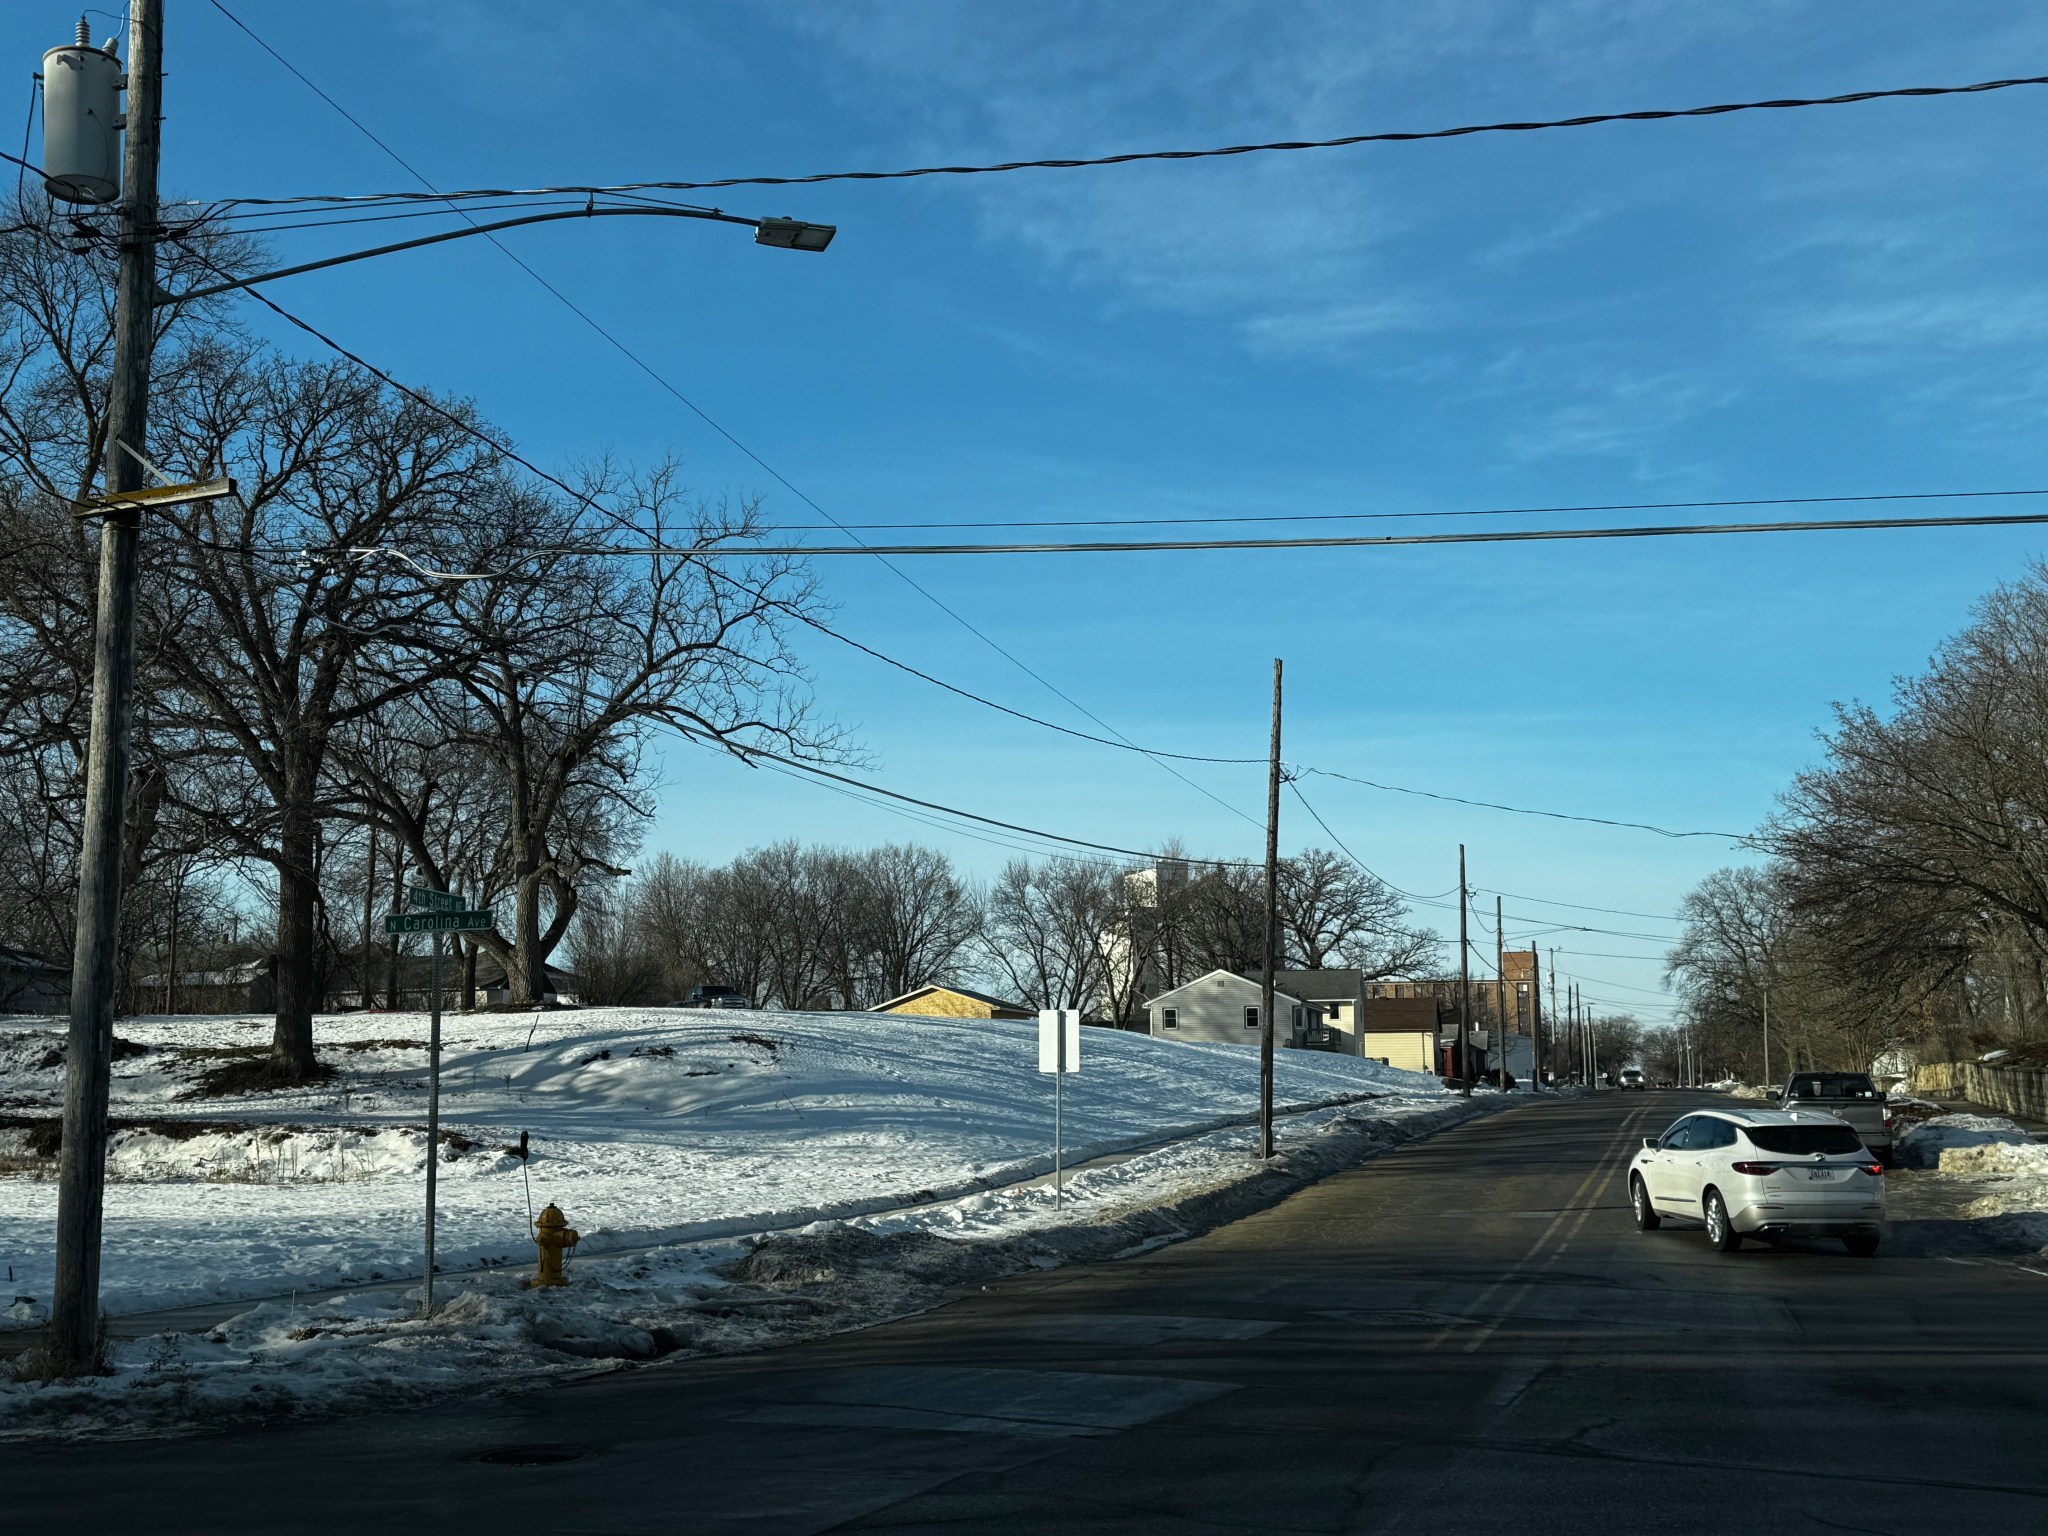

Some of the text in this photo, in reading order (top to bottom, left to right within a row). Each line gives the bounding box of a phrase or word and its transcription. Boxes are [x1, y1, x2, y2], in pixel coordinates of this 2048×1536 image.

[413, 890, 426, 906] 4th
[429, 893, 452, 911] Street
[390, 915, 486, 931] N Carolina Ave
